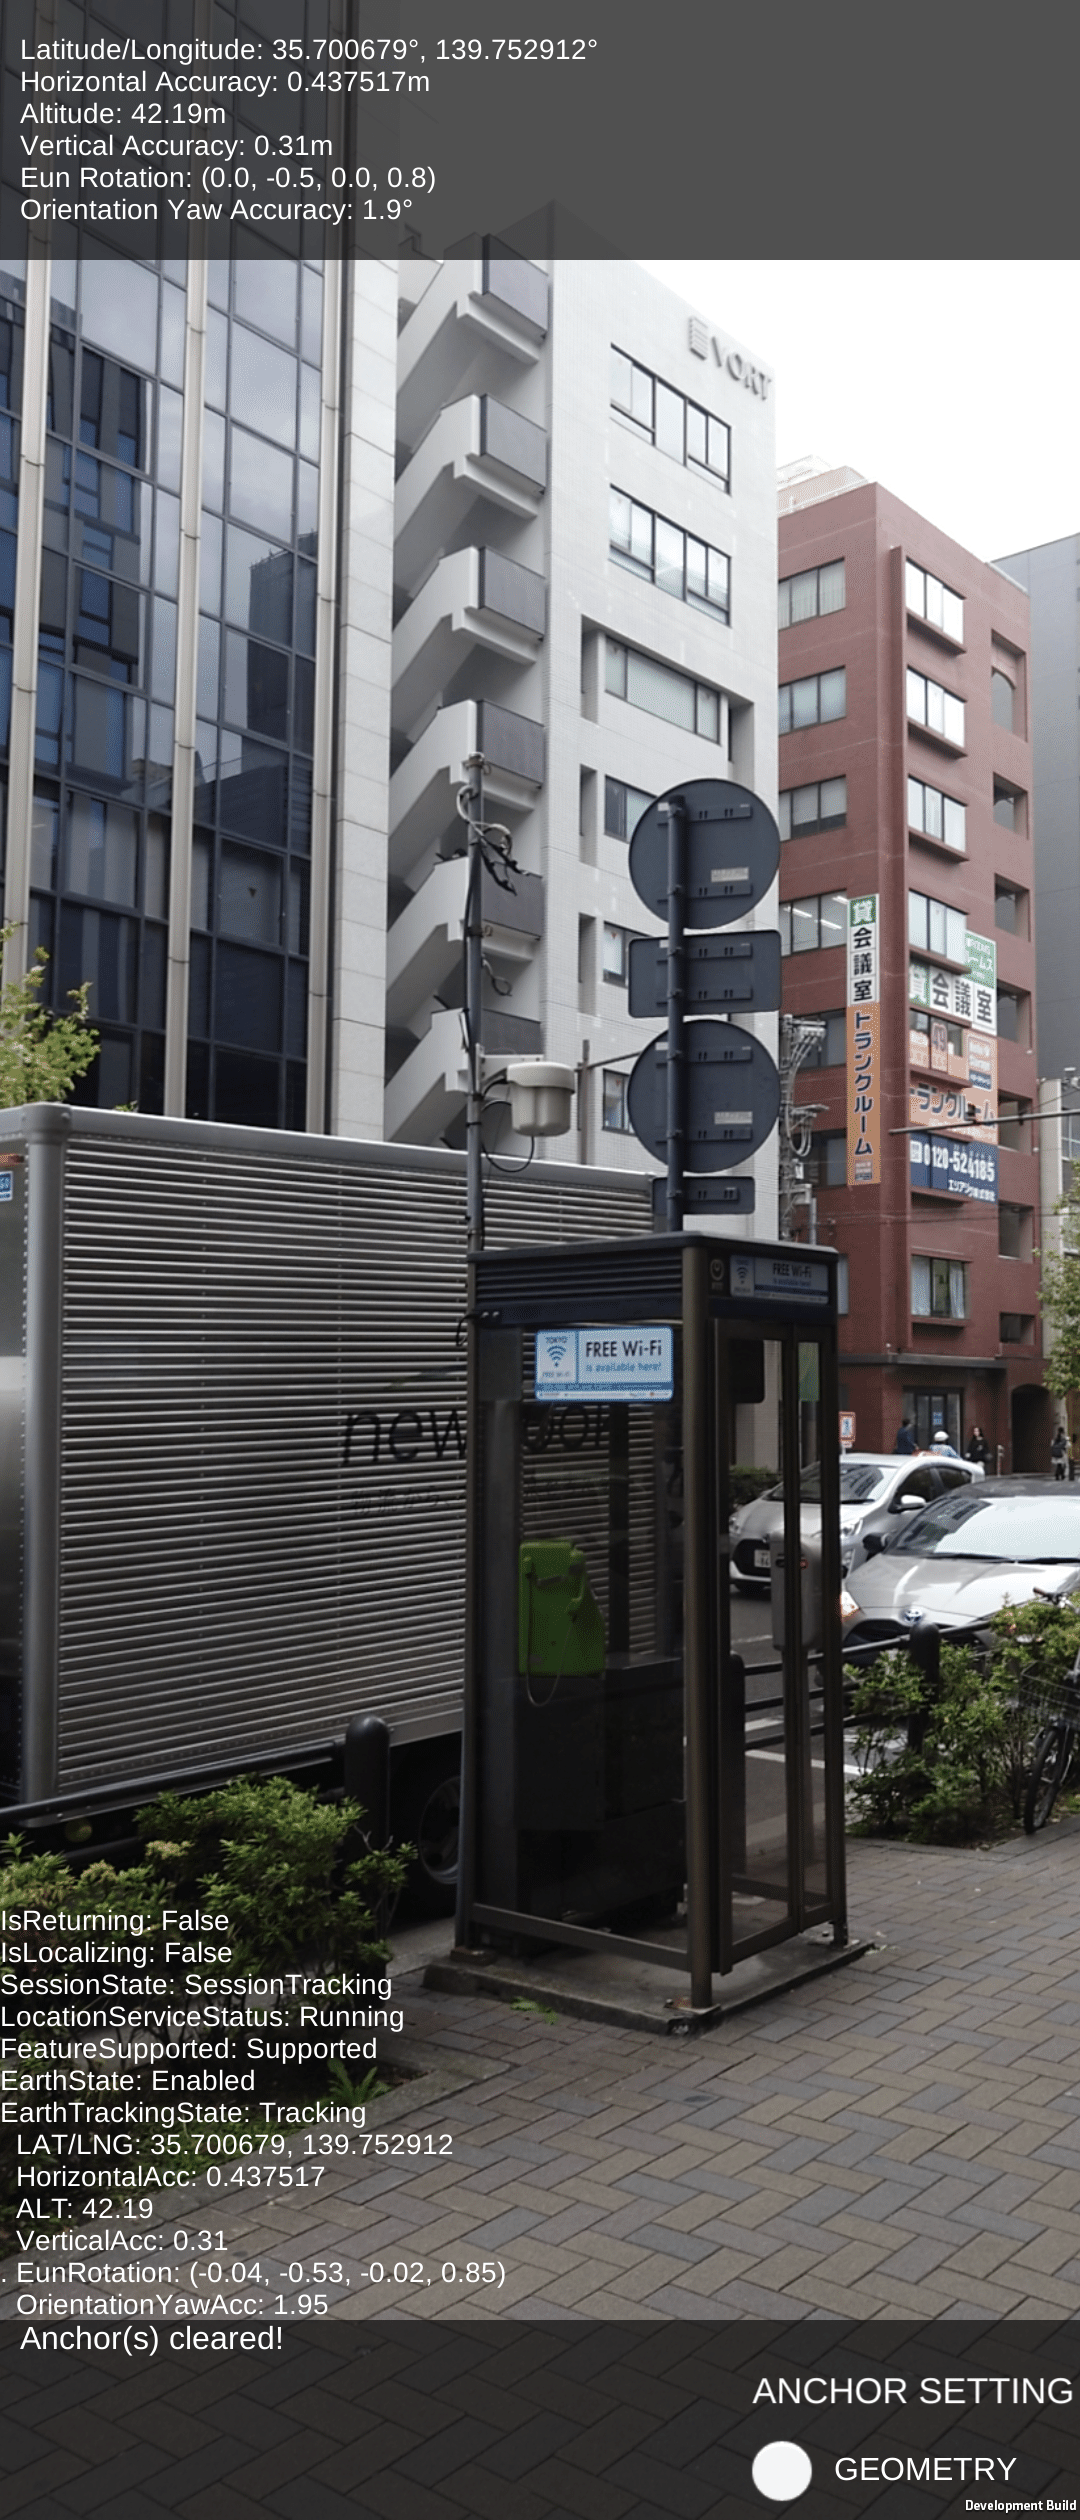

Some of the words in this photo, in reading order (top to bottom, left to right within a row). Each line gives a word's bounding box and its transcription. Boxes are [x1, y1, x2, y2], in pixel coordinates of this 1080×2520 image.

[853, 899, 873, 1003] 貸会議室
[854, 1012, 873, 1156] トランクルーム
[585, 1341, 617, 1357] FREE
[622, 1339, 662, 1357] Wi-Fi
